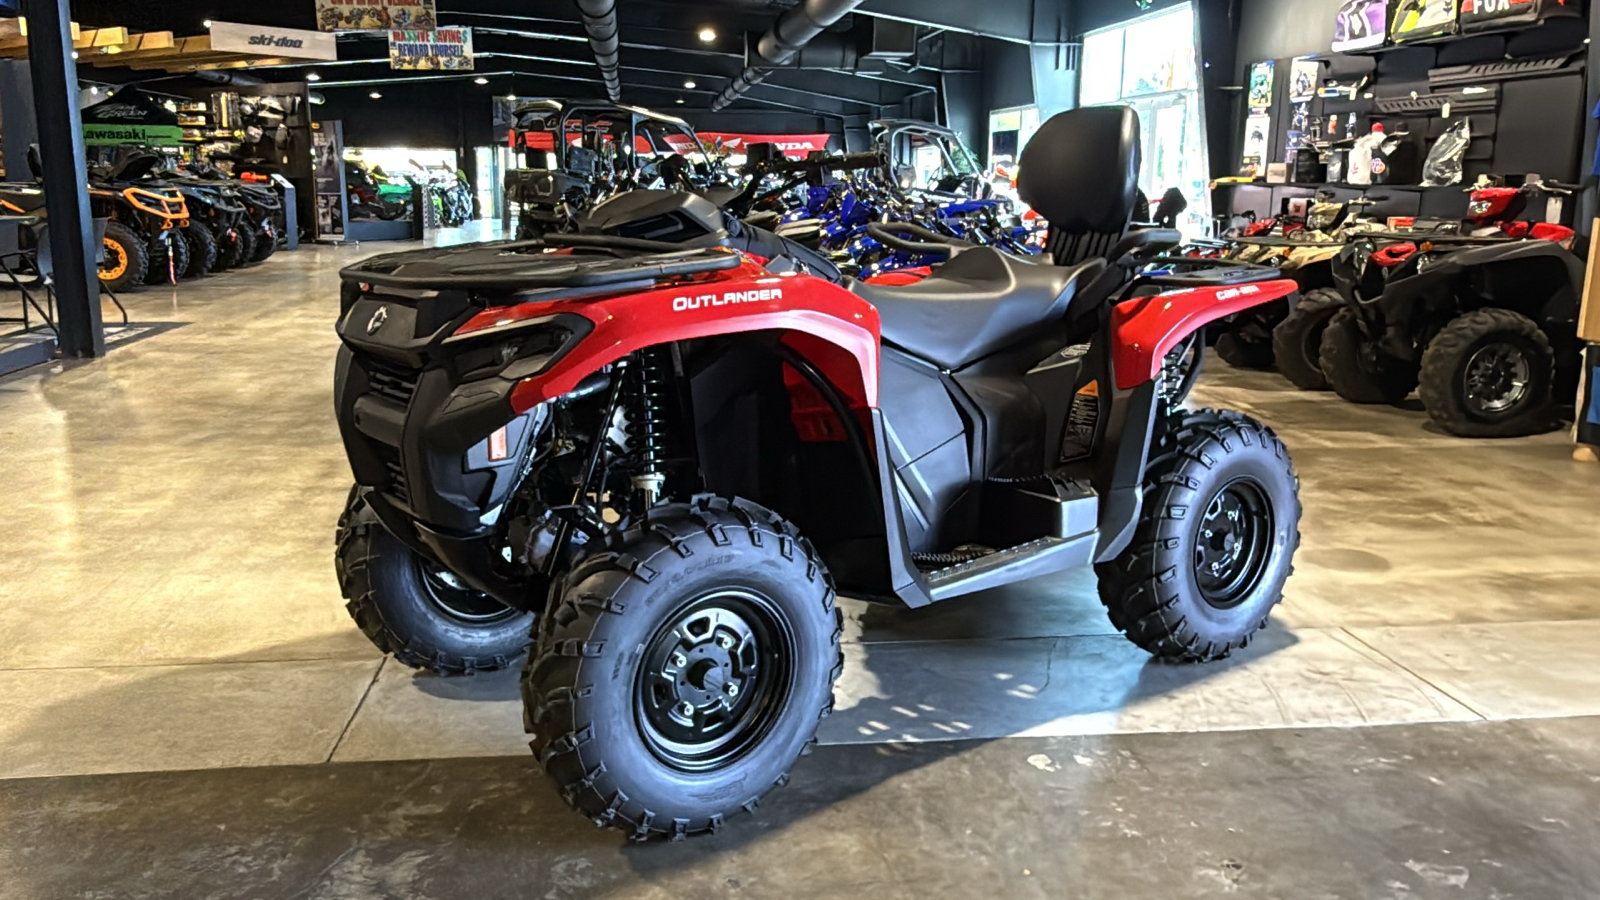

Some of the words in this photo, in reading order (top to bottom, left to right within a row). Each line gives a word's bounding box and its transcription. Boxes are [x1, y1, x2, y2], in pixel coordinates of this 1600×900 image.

[398, 43, 429, 57] REWARD
[430, 44, 464, 57] YOURSELF
[84, 128, 146, 140] awasaki
[672, 288, 783, 312] OUTLANDER
